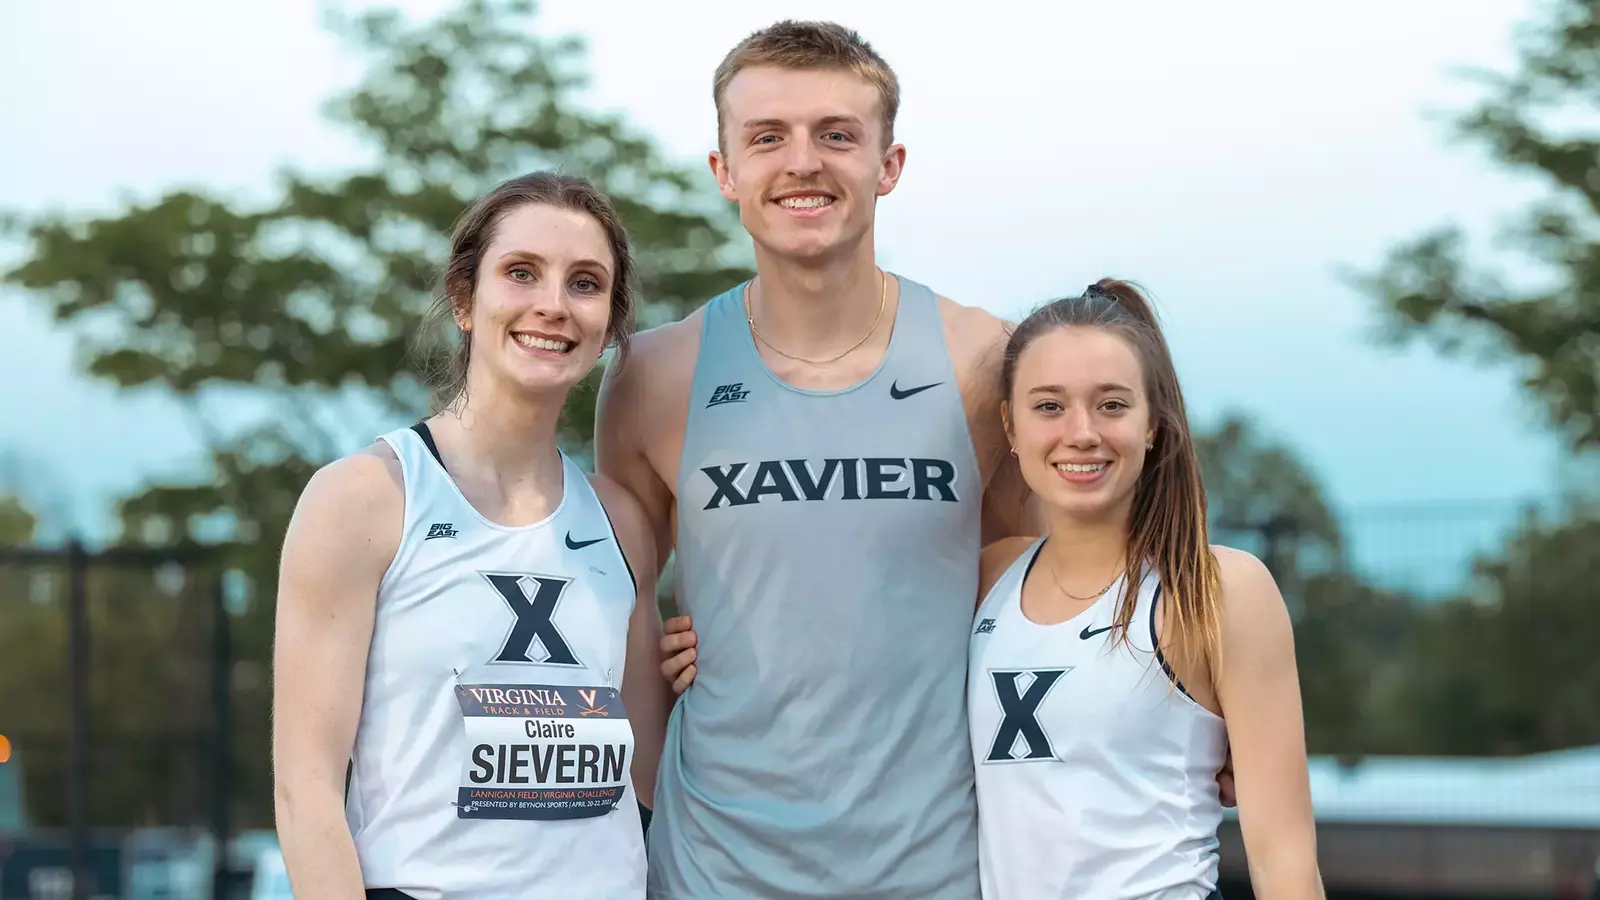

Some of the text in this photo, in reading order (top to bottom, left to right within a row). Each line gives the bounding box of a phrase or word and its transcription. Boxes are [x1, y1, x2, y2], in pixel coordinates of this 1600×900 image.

[715, 383, 744, 393] BIG
[709, 391, 751, 403] EAST
[700, 457, 959, 511] XAVIER
[431, 523, 453, 531] BIG
[476, 570, 588, 669] X
[470, 688, 568, 706] VIRGINIA
[483, 706, 520, 715] TRACK
[535, 708, 565, 716] FIELD
[981, 666, 1076, 765] X
[525, 720, 575, 738] Claire
[469, 744, 627, 784] SIEVERN
[471, 791, 517, 799] LANNIGAN
[577, 789, 617, 799] CHALLENGE
[547, 801, 568, 809] SPORTS
